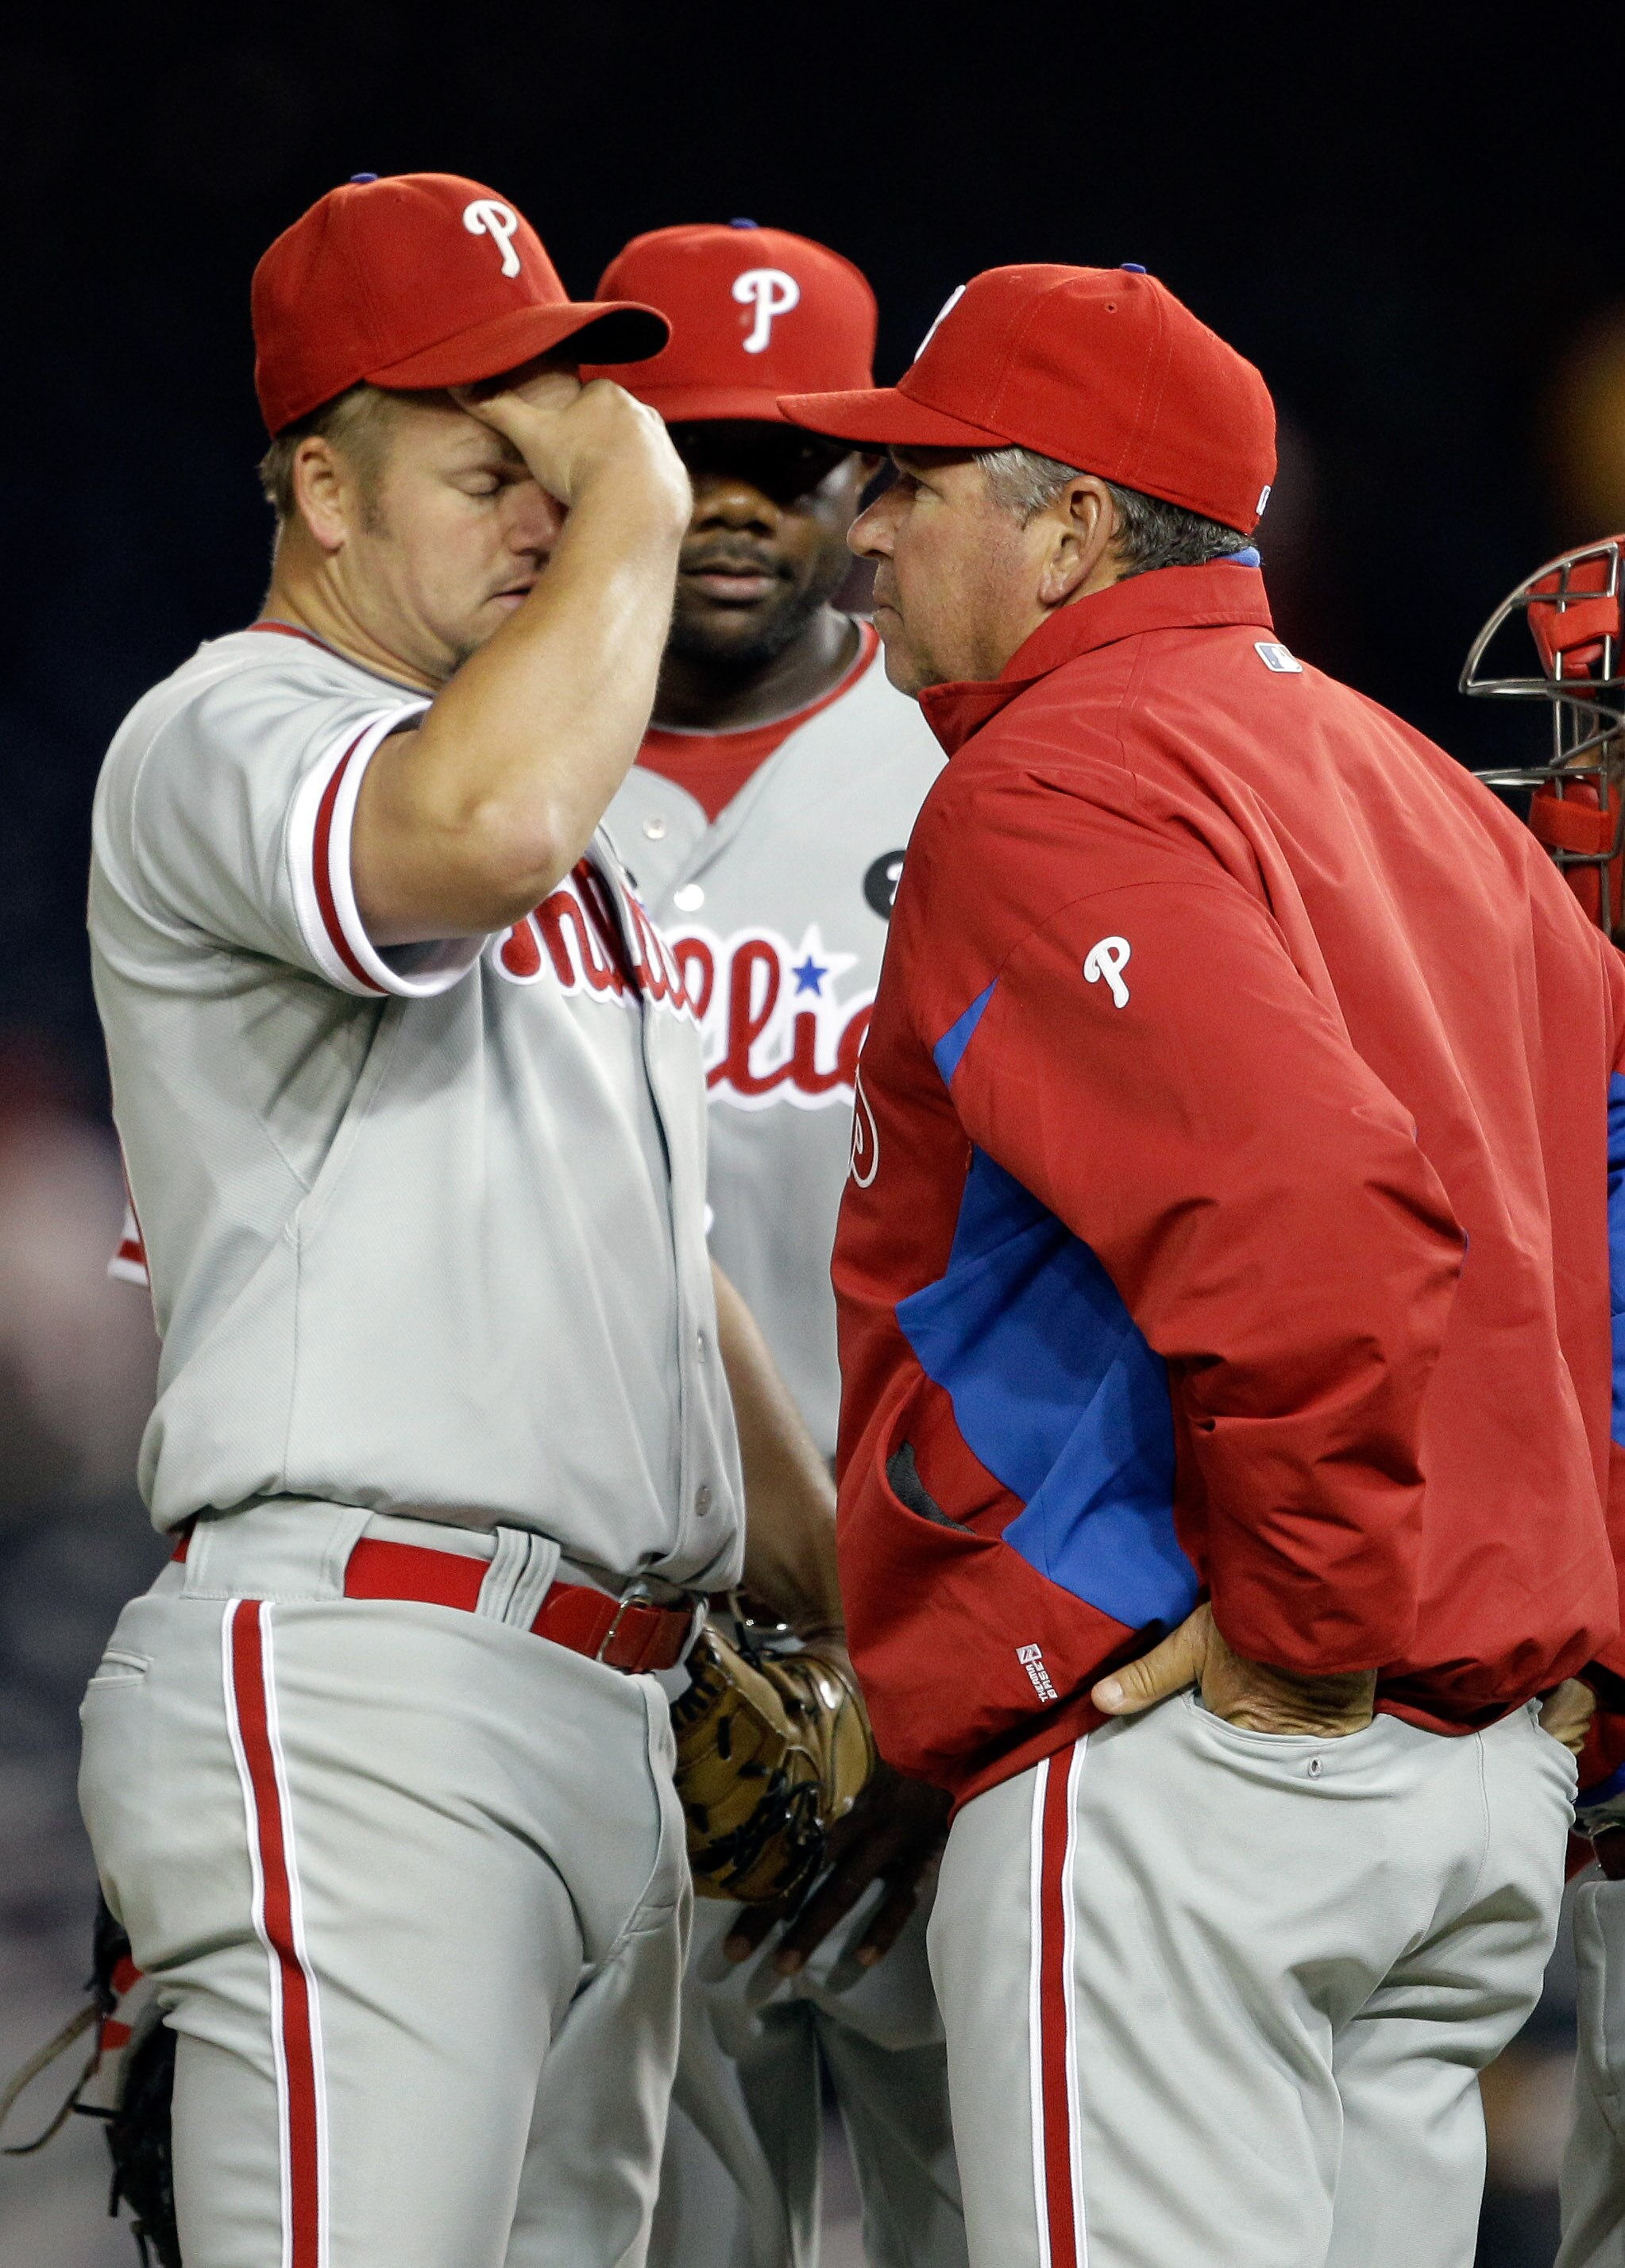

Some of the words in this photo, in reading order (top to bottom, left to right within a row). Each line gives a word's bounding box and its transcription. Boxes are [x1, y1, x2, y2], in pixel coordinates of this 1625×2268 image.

[463, 199, 520, 278] P
[731, 268, 800, 353] P
[1083, 935, 1131, 1009] P
